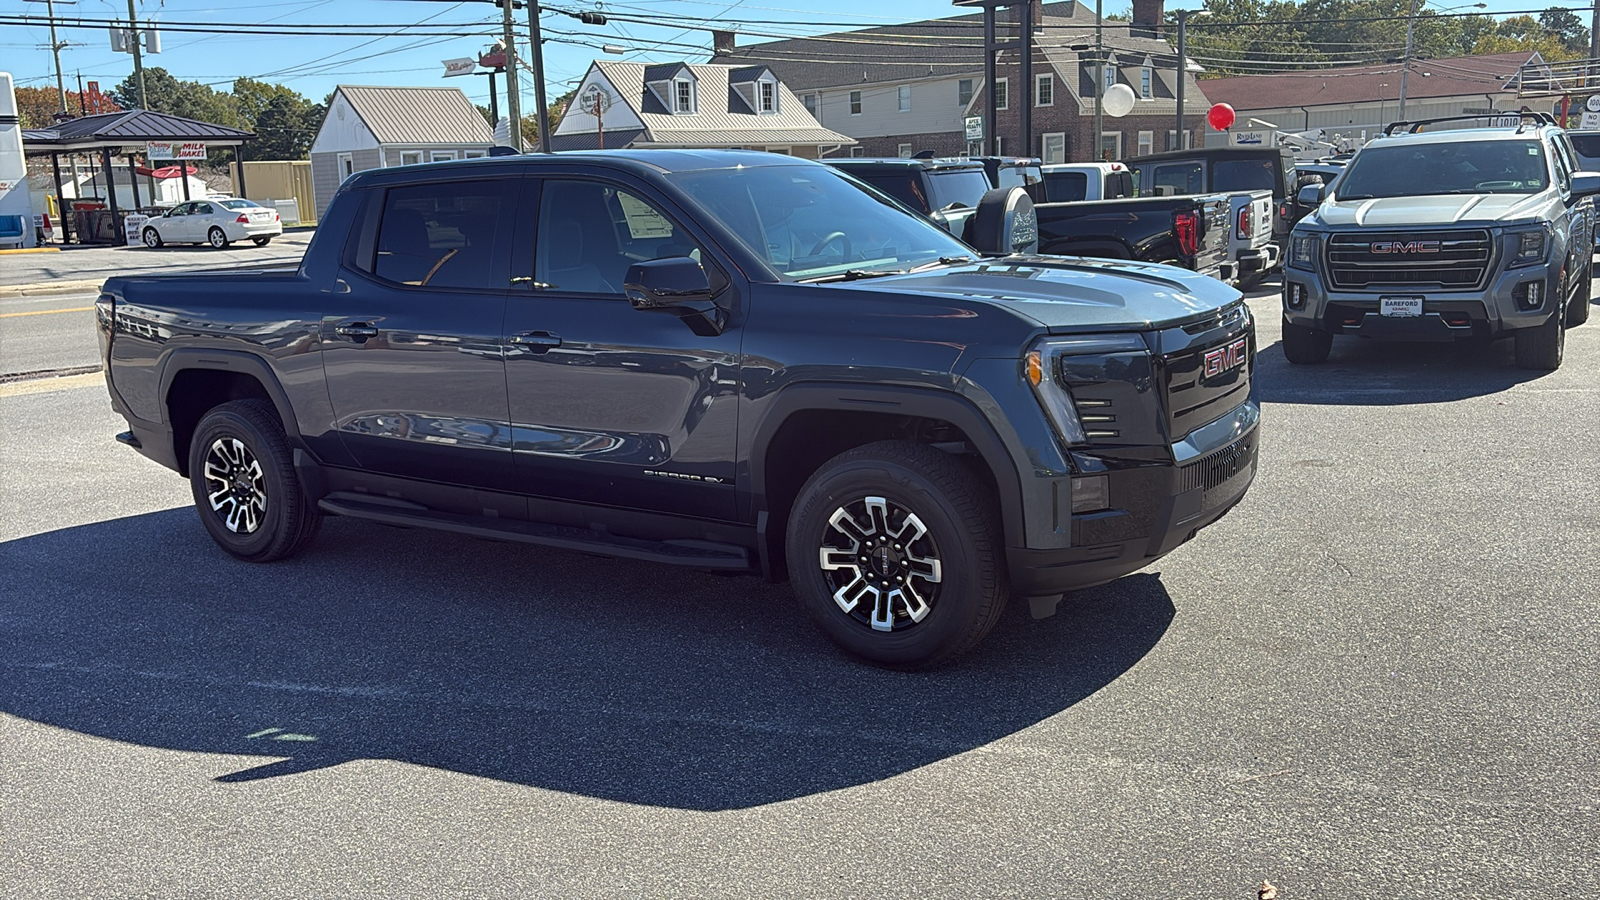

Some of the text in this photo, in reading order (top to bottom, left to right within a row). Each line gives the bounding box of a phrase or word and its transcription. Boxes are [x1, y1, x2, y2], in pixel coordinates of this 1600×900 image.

[1590, 98, 1600, 107] 100
[1500, 117, 1518, 127] 1010
[1371, 241, 1439, 253] GMC
[1204, 339, 1245, 379] GMC
[643, 470, 701, 481] SIERRA
